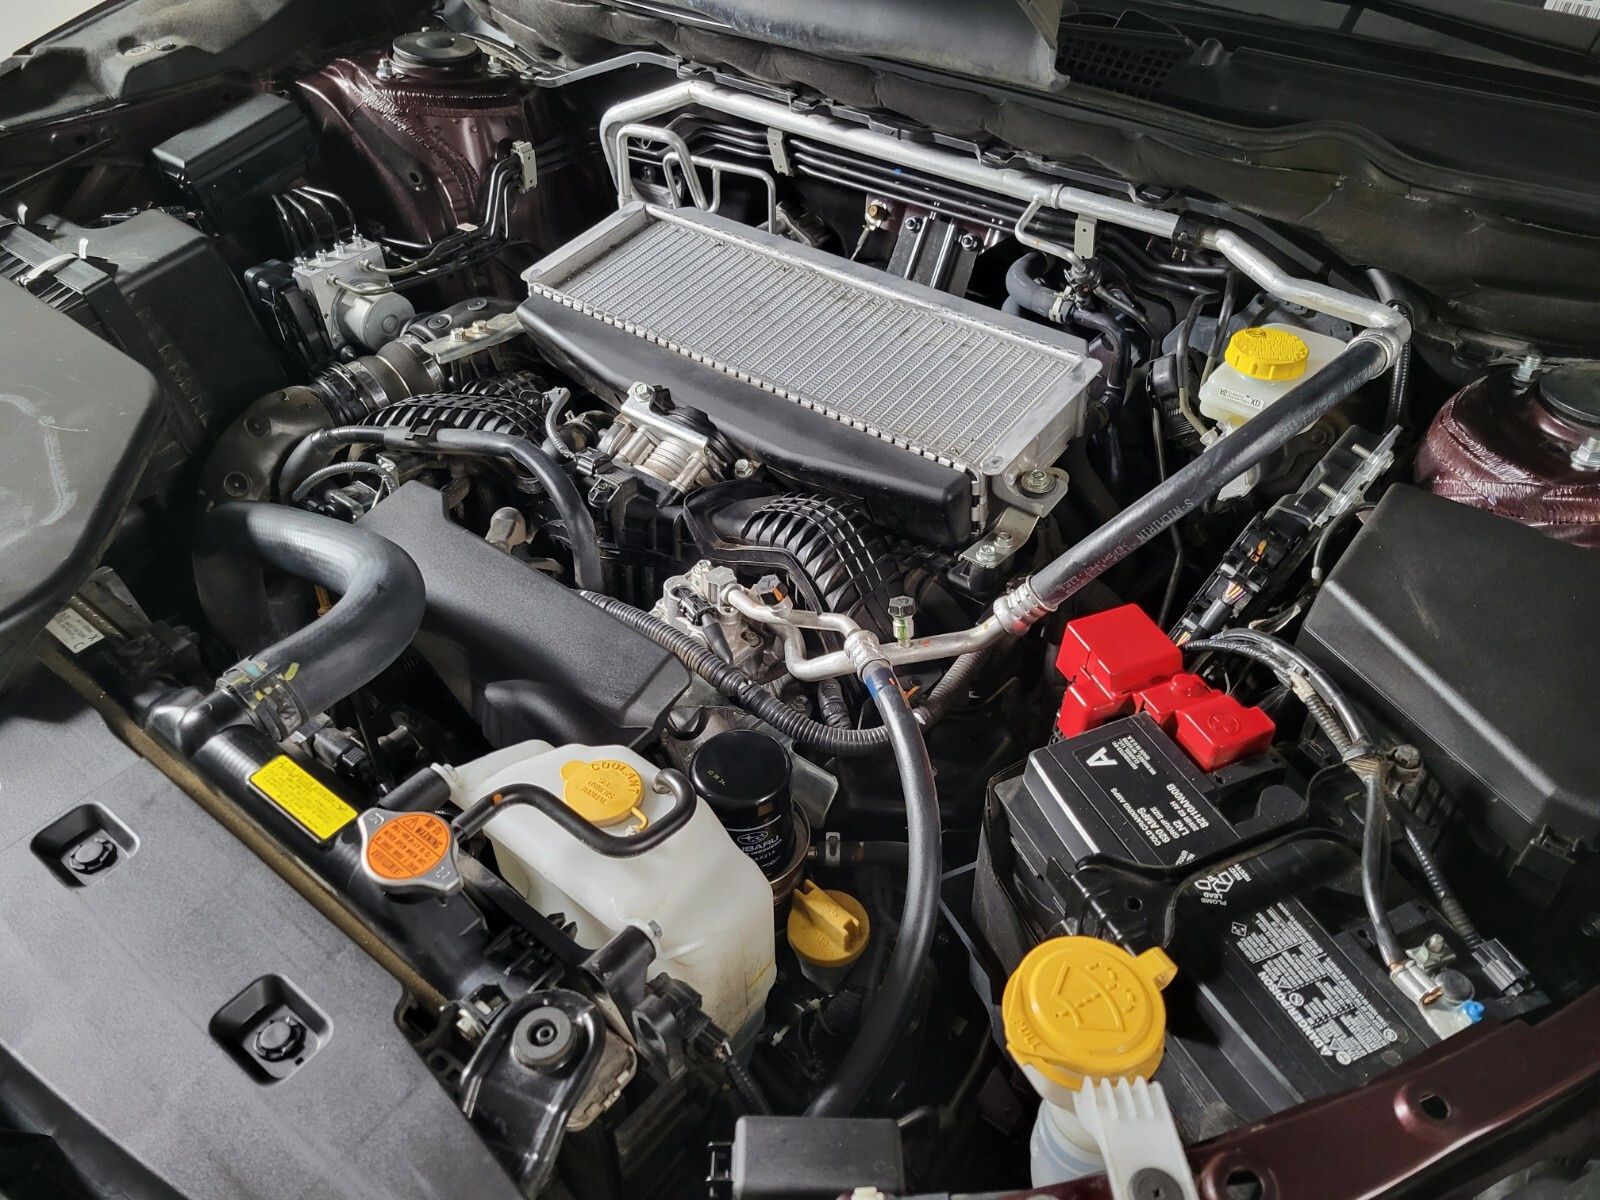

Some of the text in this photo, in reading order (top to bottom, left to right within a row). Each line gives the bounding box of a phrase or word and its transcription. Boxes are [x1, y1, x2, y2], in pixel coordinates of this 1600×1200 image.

[1086, 746, 1118, 766] A
[591, 761, 640, 795] COOLANT
[1110, 787, 1161, 846] COLD CRANKING AMPS
[1166, 783, 1210, 828] 82110AN00B
[1169, 800, 1181, 810] AH
[1137, 807, 1171, 843] 620 AMPS
[1150, 806, 1180, 839] GROUP SIZE
[1173, 819, 1190, 836] LN2
[741, 834, 779, 852] BARU
[1202, 891, 1223, 900] LEAD
[1257, 971, 1325, 1049] DANGER/POISON
